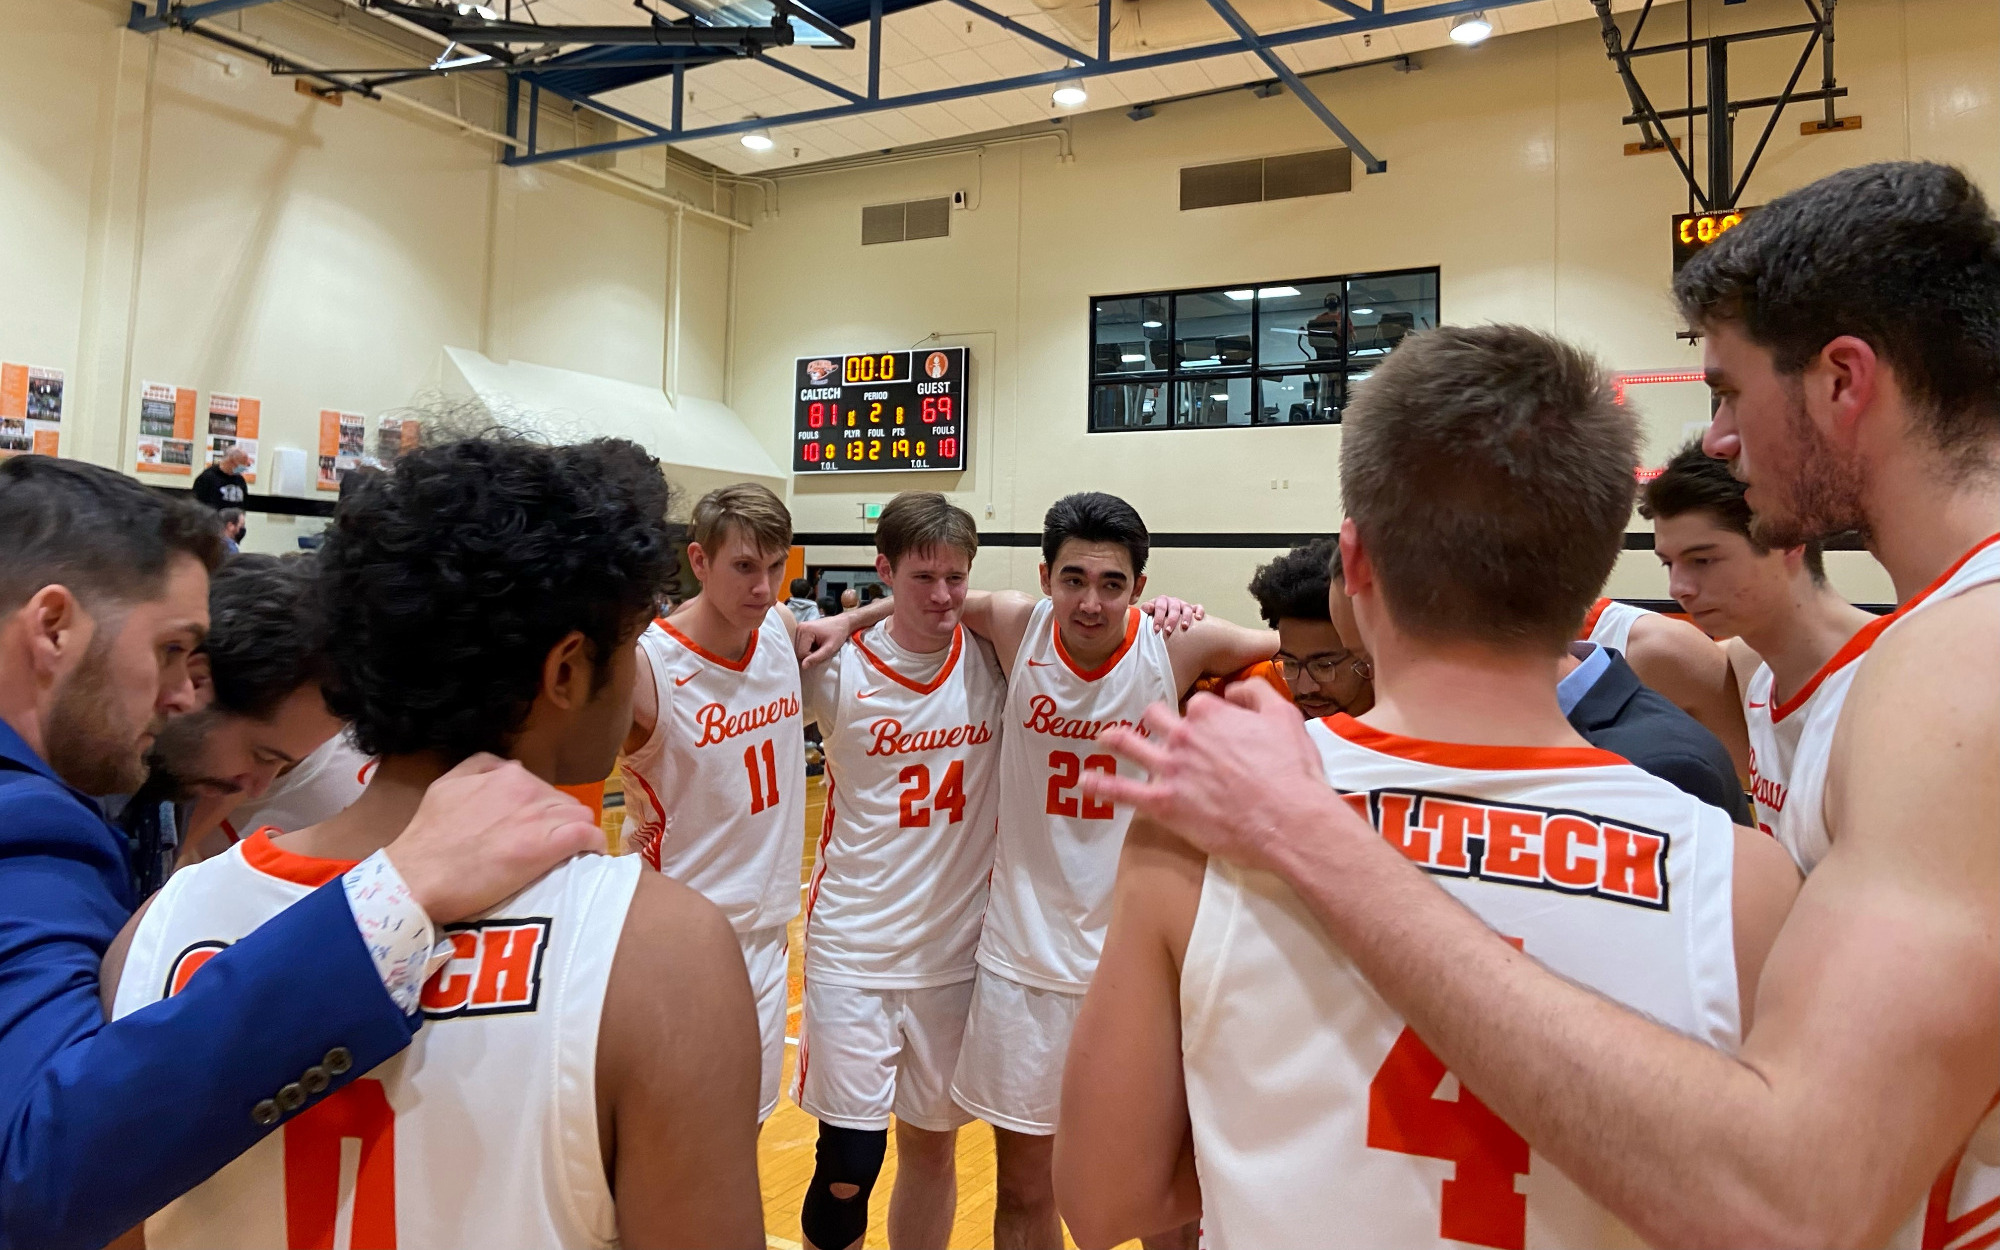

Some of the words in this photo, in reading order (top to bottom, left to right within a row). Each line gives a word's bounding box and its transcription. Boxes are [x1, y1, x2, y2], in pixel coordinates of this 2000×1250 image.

[847, 355, 894, 382] 00.0
[800, 387, 841, 401] CALTECH
[863, 391, 888, 401] PERIOD
[917, 381, 951, 395] GUEST
[808, 402, 838, 428] 81
[869, 402, 882, 423] 2
[922, 396, 952, 423] 69
[798, 430, 819, 440] FOULS
[843, 429, 861, 438] PLYR
[867, 428, 885, 438] FOUL
[892, 427, 906, 437] PTS
[932, 426, 955, 435] FOULS
[803, 442, 820, 462] 10
[825, 443, 836, 460] 0
[847, 440, 864, 461] 13
[868, 440, 881, 461] 2
[892, 439, 910, 458] 19
[915, 440, 926, 457] 0
[938, 437, 957, 458] 10
[820, 461, 838, 470] T.O.L.
[910, 459, 930, 468] T.O.L.
[695, 691, 800, 747] Beavers
[865, 718, 993, 756] Beavers
[743, 738, 780, 816] 11
[1045, 749, 1117, 820] 22
[898, 759, 967, 829] 24
[1340, 788, 1668, 911] LTECH
